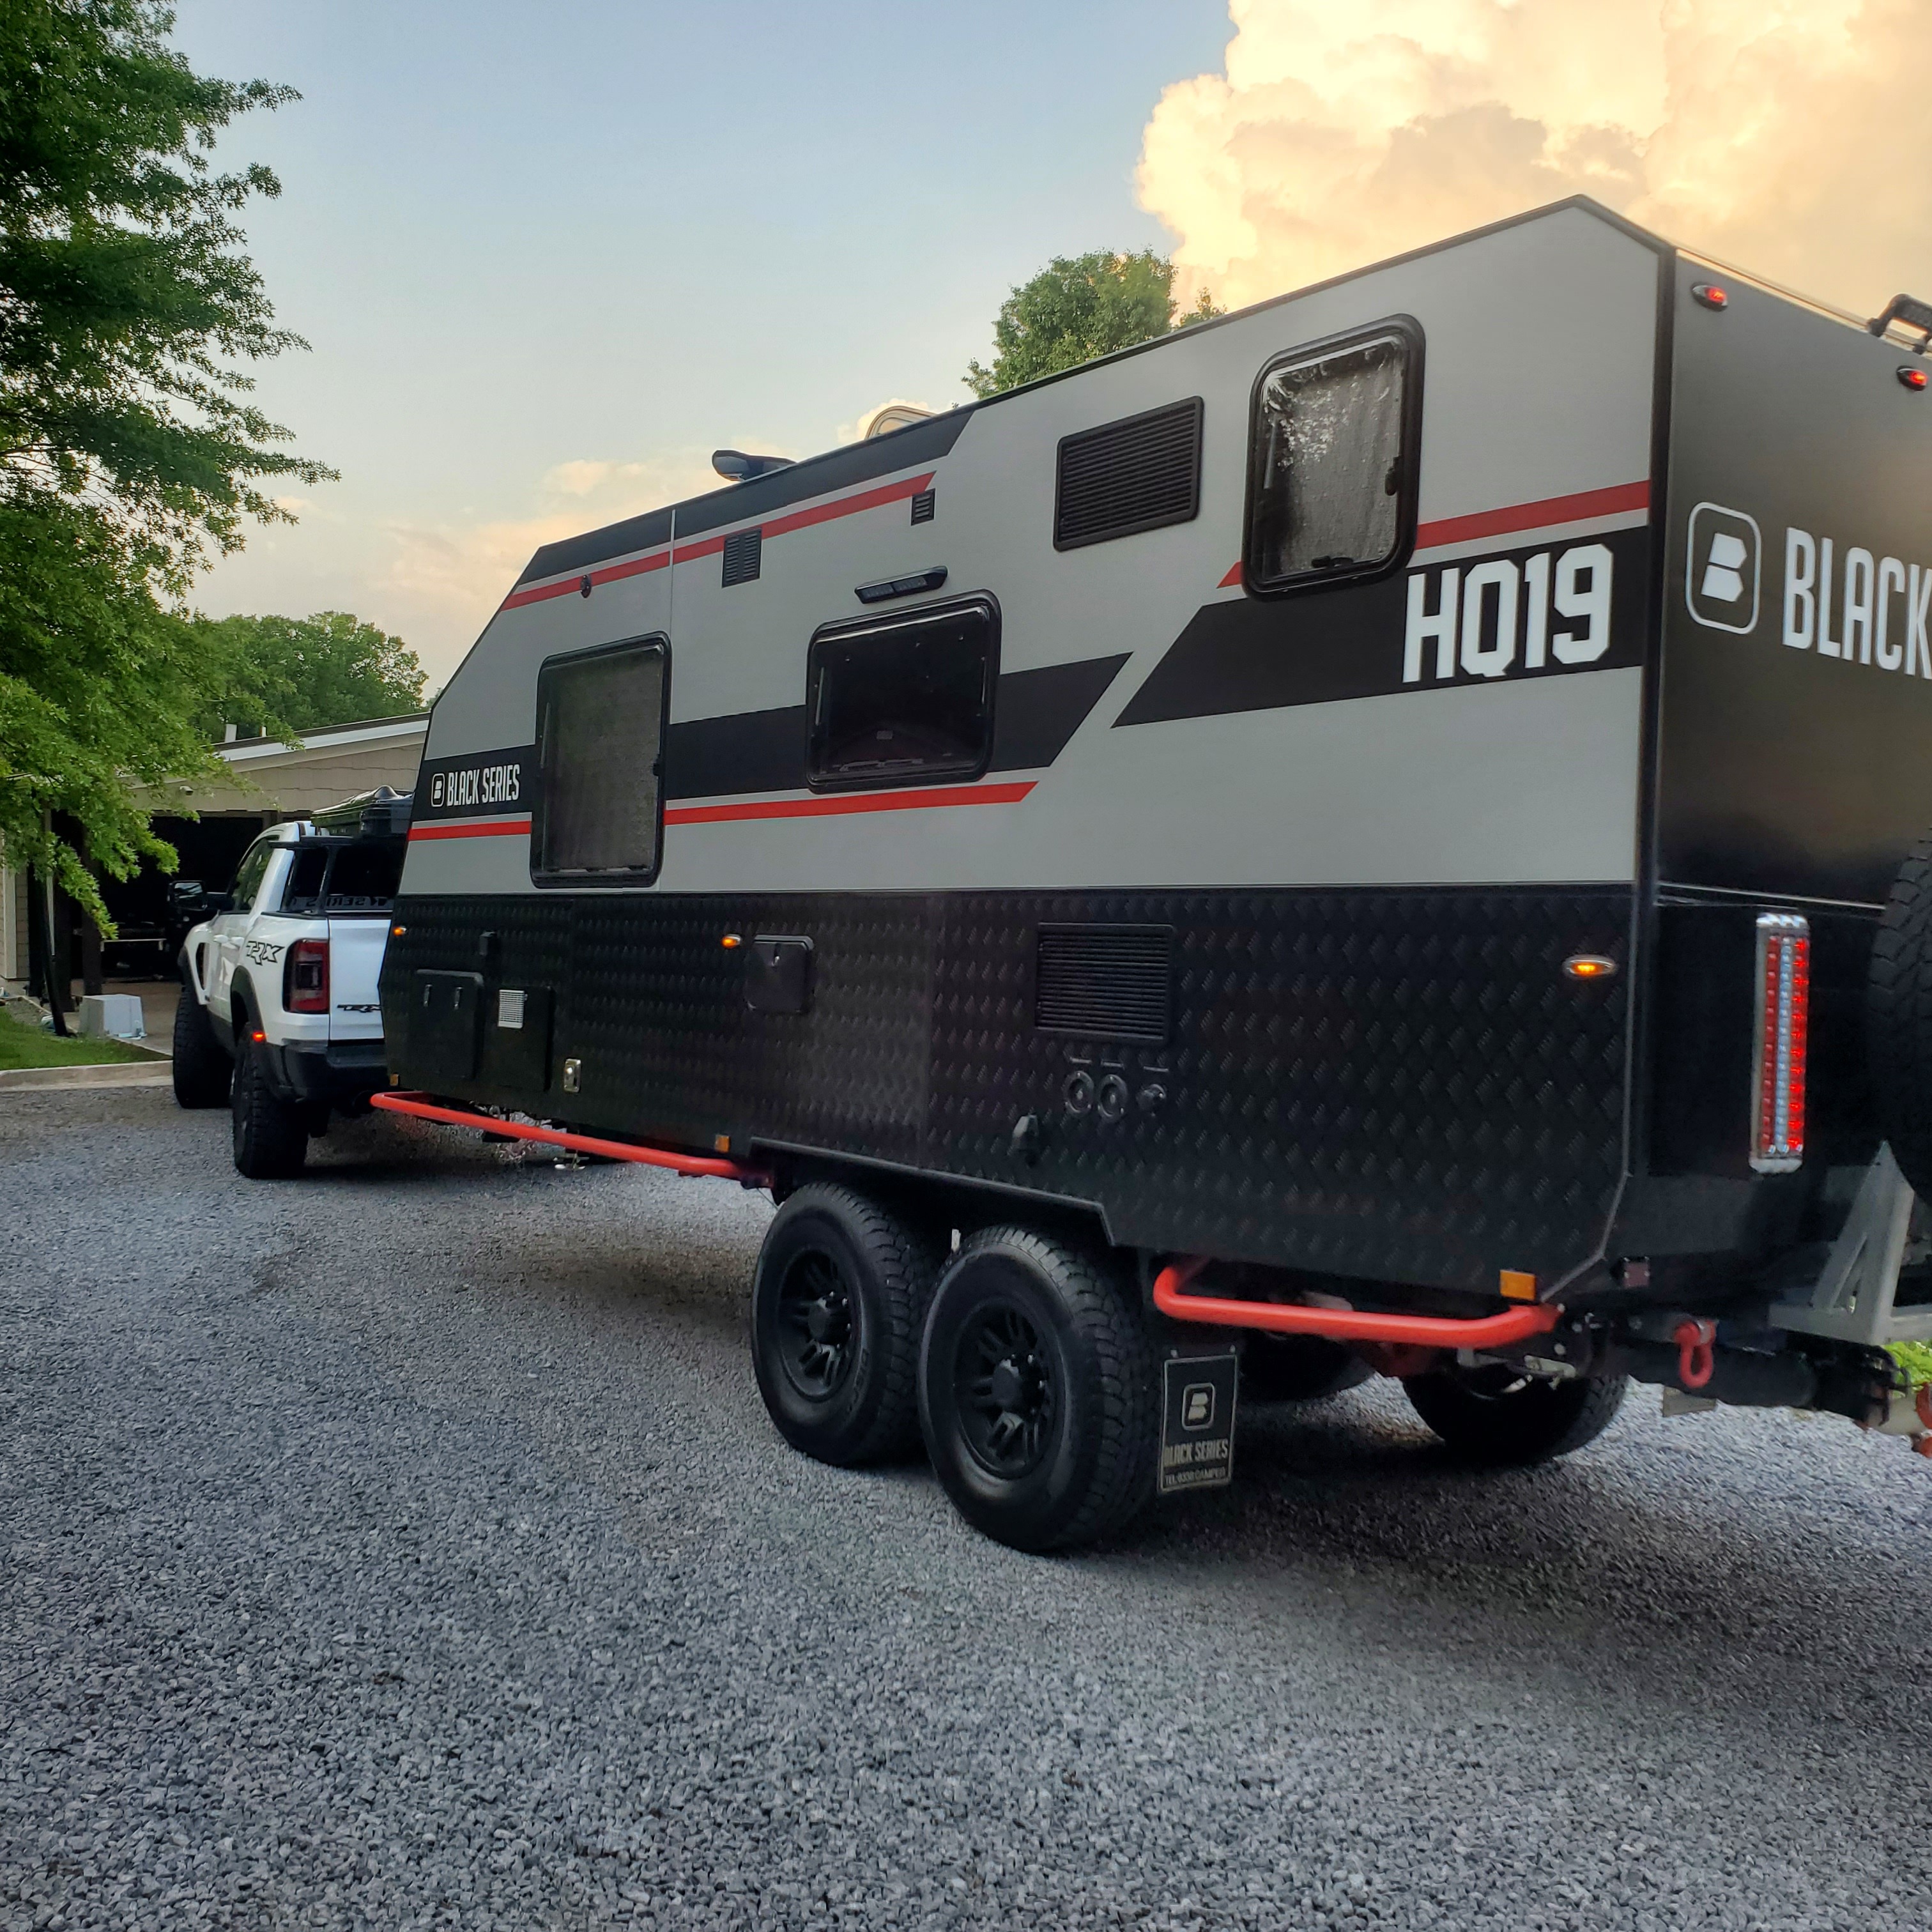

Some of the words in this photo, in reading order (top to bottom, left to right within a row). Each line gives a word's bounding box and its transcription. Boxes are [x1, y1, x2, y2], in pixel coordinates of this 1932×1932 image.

[1402, 543, 1614, 683] HQ19
[1782, 526, 1932, 680] BLACK
[447, 769, 480, 806] BLACK
[482, 764, 520, 803] SERIES
[245, 940, 285, 966] TRX
[1163, 1442, 1193, 1468] BLACK
[1195, 1438, 1229, 1462] SERIES
